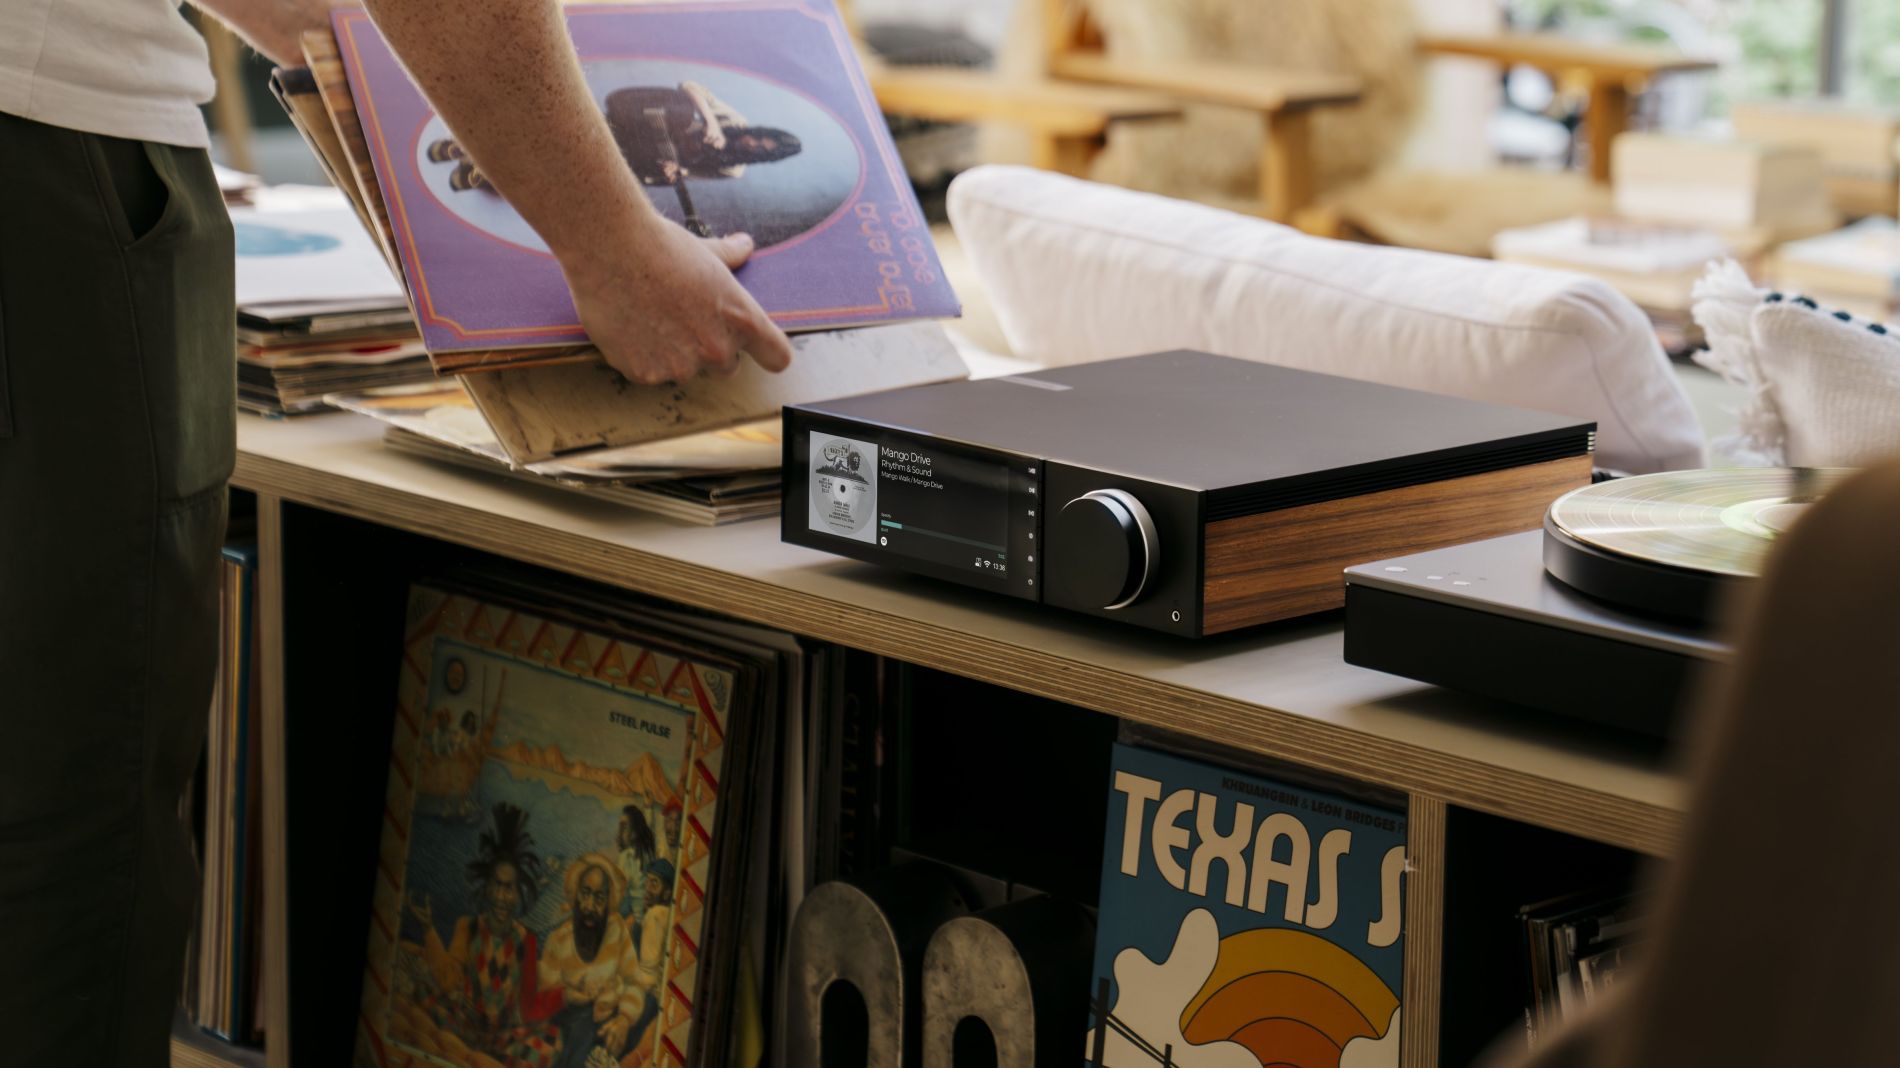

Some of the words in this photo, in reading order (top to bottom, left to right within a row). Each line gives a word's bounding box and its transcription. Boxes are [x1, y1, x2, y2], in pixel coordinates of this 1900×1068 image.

[881, 446, 910, 462] Mango
[910, 452, 931, 466] Drive
[881, 459, 906, 471] Rhythm
[906, 464, 912, 473] &
[911, 465, 932, 477] Sound
[881, 470, 898, 481] Mango
[898, 474, 911, 482] Walk
[913, 477, 931, 488] Mango
[930, 481, 944, 490] Drive
[609, 710, 639, 730] STEEL
[640, 719, 671, 739] PULSE
[1221, 776, 1299, 808] KHRUANGBIN
[1300, 796, 1309, 809] &
[1311, 799, 1343, 818] LEON
[1344, 808, 1396, 833] BRIDGES
[1113, 769, 1352, 930] TEXAS
